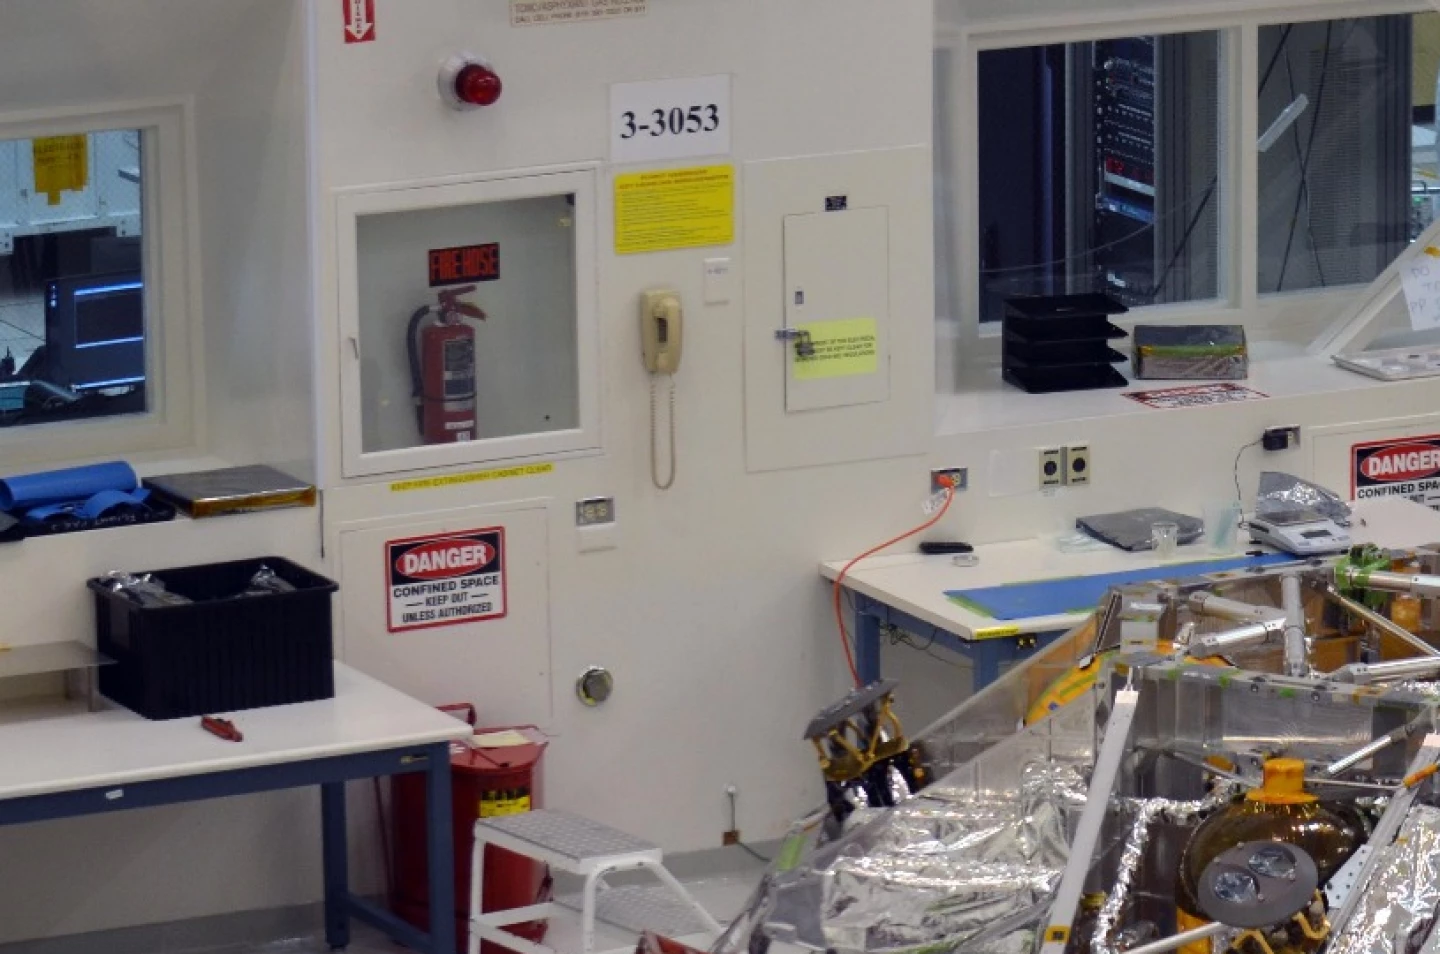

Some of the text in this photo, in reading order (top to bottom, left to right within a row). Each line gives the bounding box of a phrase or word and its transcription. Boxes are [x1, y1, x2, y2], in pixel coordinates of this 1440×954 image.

[620, 103, 720, 139] 3-3053
[429, 247, 499, 281] FIRE HOSE
[1411, 265, 1430, 279] DO
[1357, 483, 1416, 499] CONFINED
[404, 545, 487, 575] DANGER
[393, 575, 499, 599] CONFINED SPACE
[425, 592, 468, 607] KEEP OUT
[402, 602, 493, 623] UNLESS AUTHORIZED
